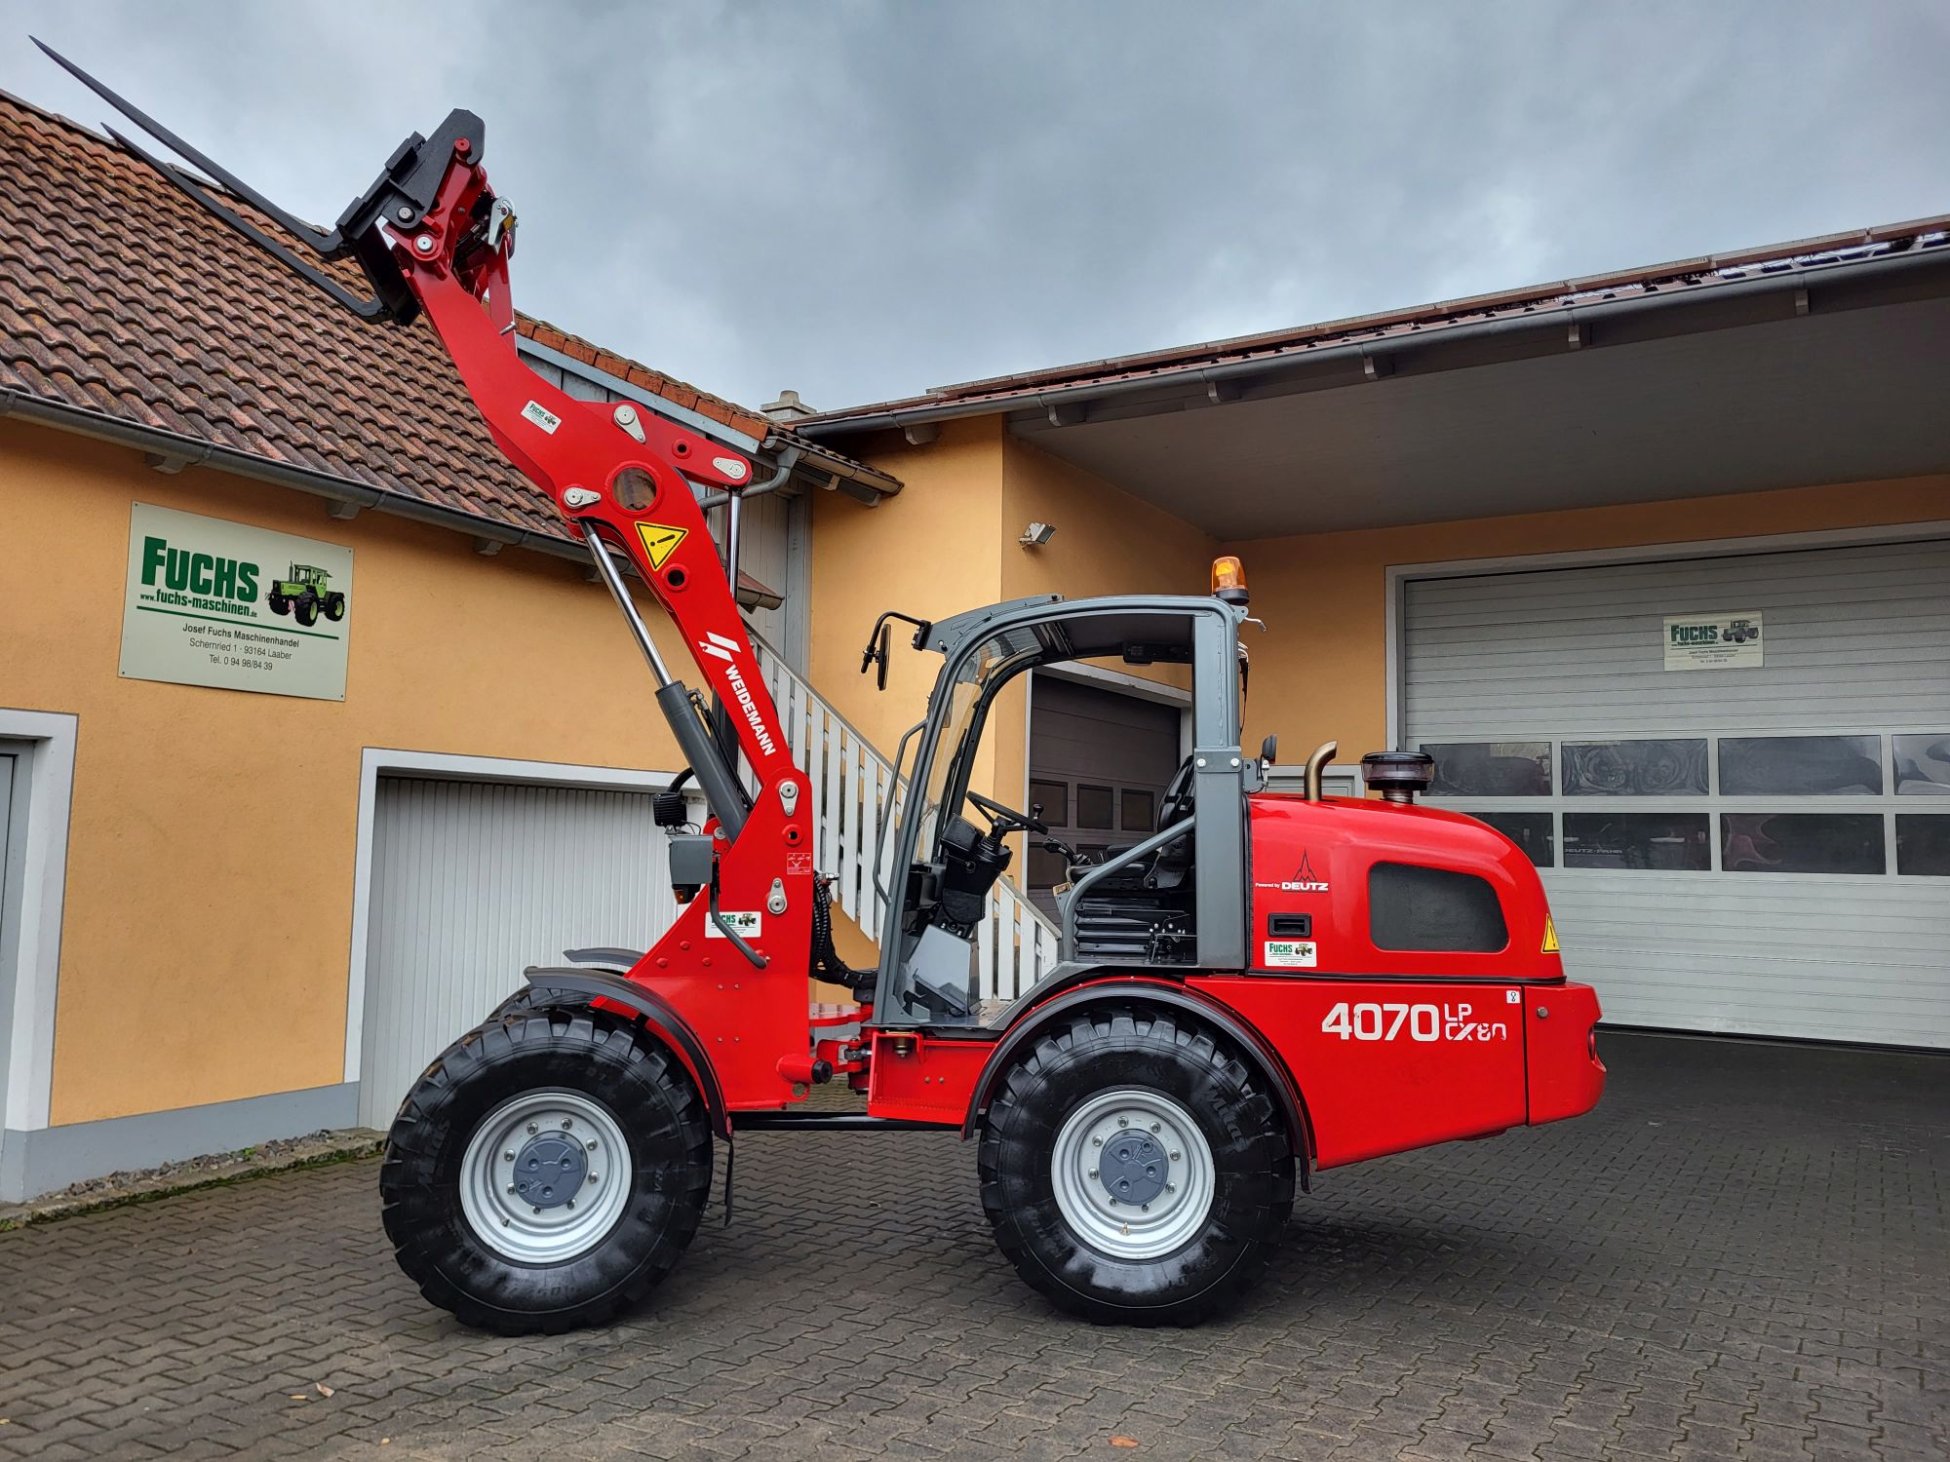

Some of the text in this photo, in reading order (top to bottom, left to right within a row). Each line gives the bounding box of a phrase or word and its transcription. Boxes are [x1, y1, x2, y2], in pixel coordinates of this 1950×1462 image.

[141, 536, 260, 603] FUCHS
[140, 588, 258, 618] www.fuchs-maschinen.de
[182, 623, 300, 648] Josef Fuchs Maschinenhandel
[1671, 625, 1718, 641] FUCHS
[189, 637, 231, 652] Schernried
[233, 644, 238, 653] 1
[244, 645, 266, 656] 93164
[267, 649, 293, 660] Laaber
[209, 654, 222, 664] Tel.
[223, 656, 229, 666] 0
[230, 657, 240, 666] 94
[263, 662, 273, 671] 39
[725, 664, 777, 757] WEIDEMANN
[1281, 881, 1329, 891] DEUTZ
[1269, 942, 1293, 953] FUCHS
[1321, 1002, 1473, 1042] 4070 LP
